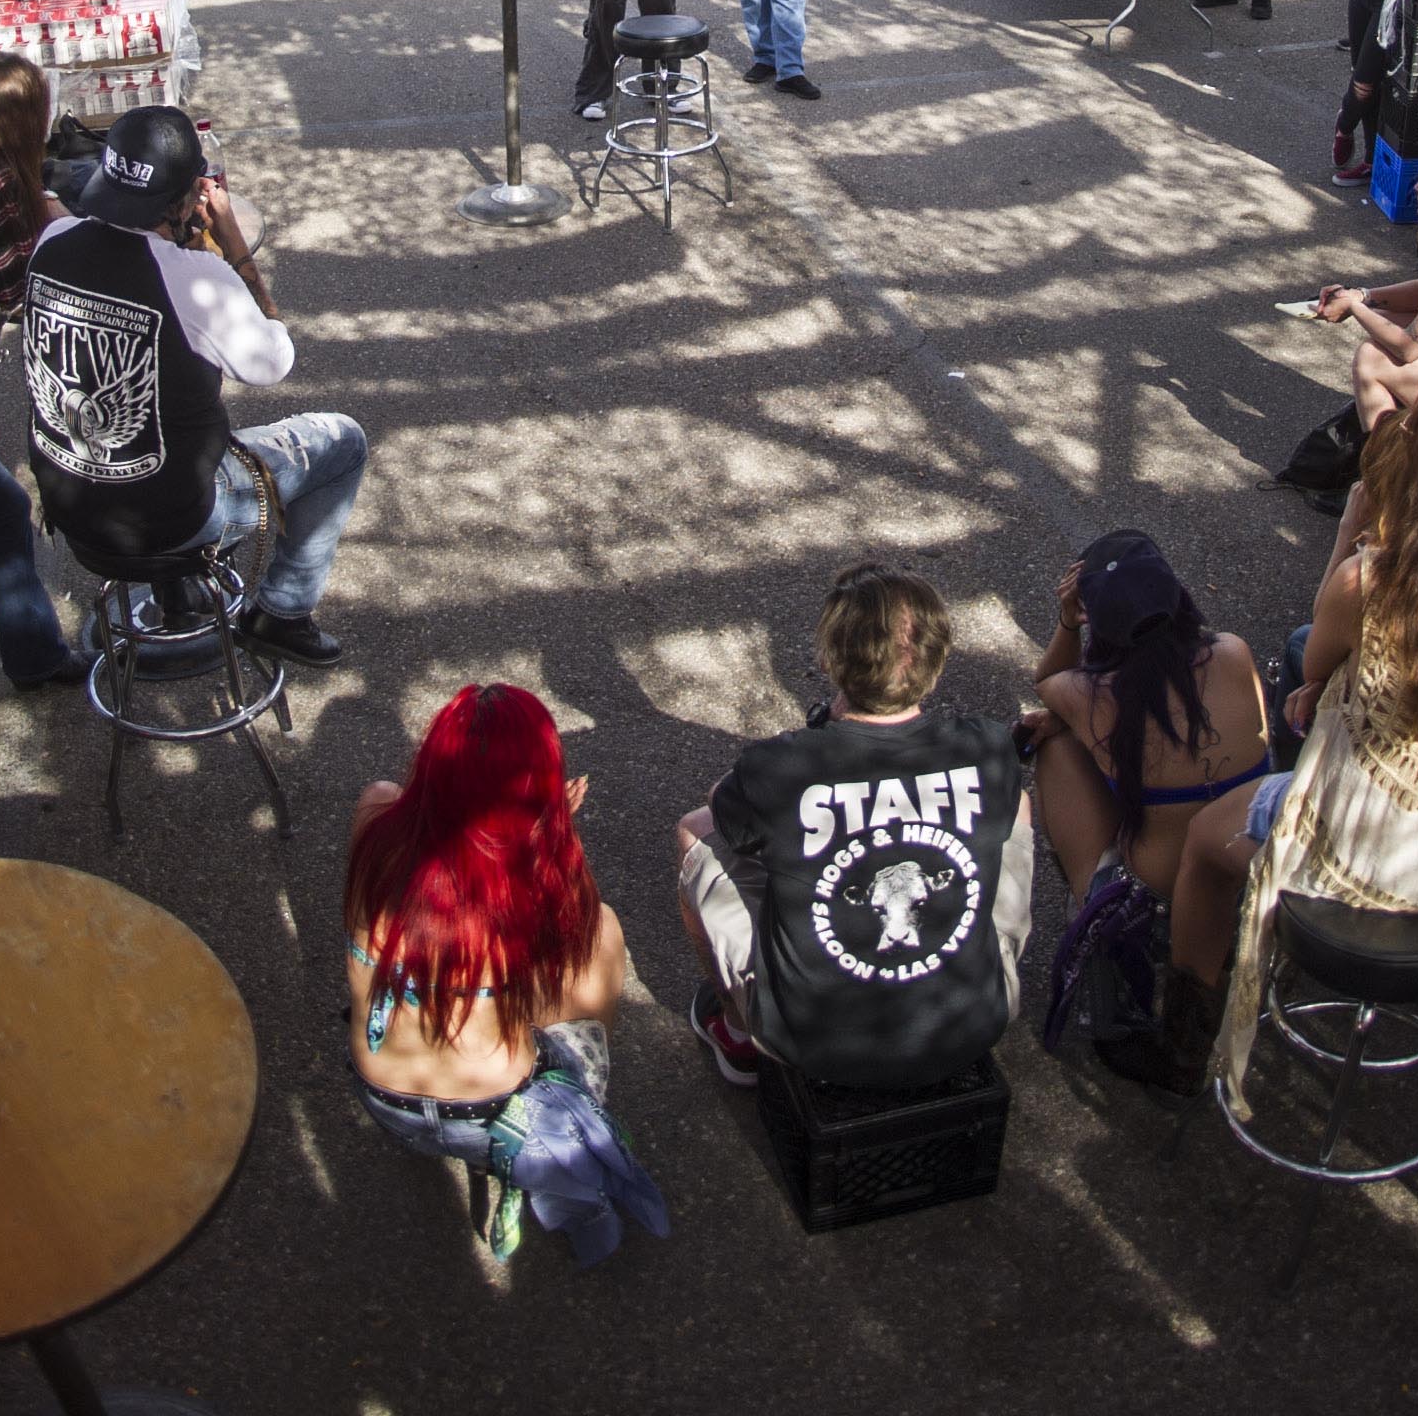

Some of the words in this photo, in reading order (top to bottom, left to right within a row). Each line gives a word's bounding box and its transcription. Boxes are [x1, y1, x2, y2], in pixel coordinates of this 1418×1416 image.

[41, 285, 151, 324] FOREVERTWOWHEELSMAINE
[32, 307, 142, 388] FTW
[43, 441, 93, 475] UNITED
[93, 460, 152, 477] STATES
[799, 765, 982, 857] STAFF
[815, 838, 866, 898] HOGS
[872, 828, 894, 848] &
[902, 824, 978, 878] HEIFERS
[811, 901, 875, 979] SALOON
[897, 953, 942, 981] LAS
[941, 879, 981, 952] VEGAS
